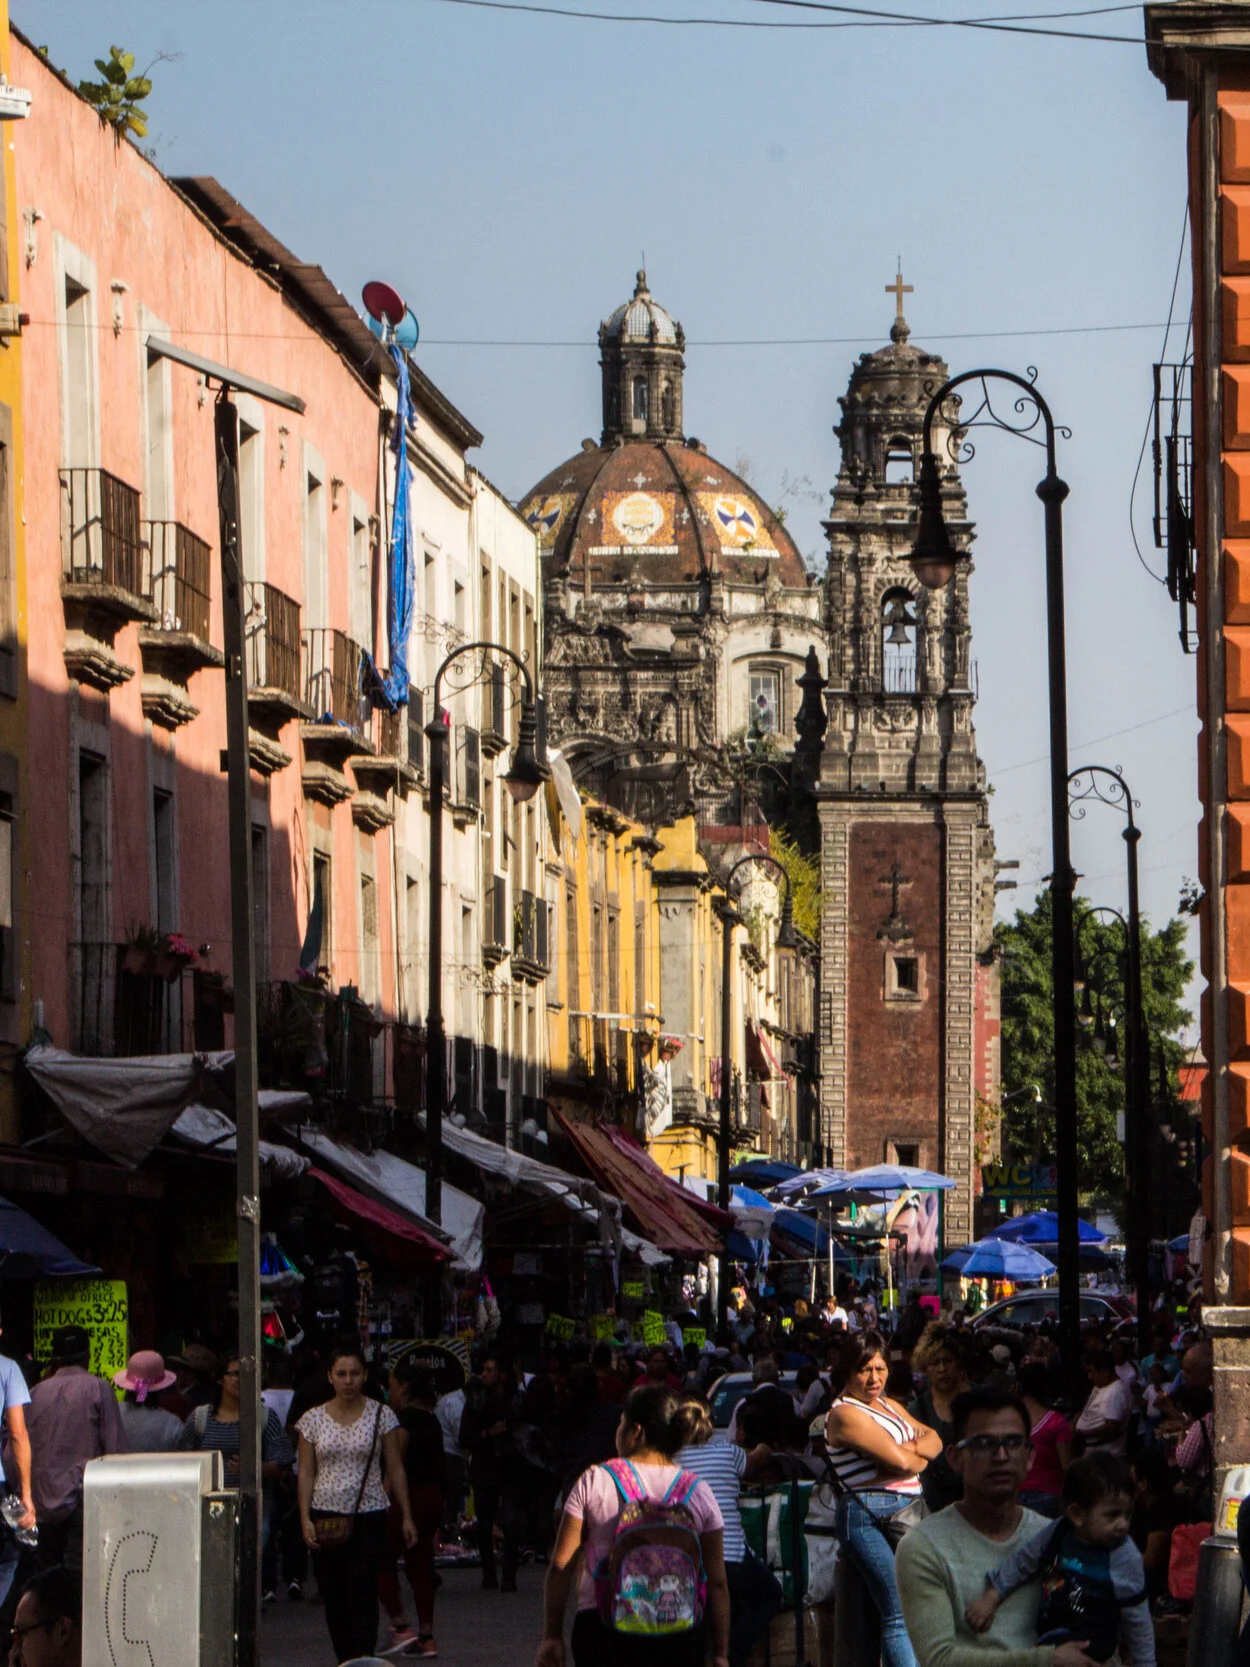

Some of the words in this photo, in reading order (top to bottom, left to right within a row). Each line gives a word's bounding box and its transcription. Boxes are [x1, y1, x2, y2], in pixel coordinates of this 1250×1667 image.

[982, 1166, 1031, 1187] WC
[80, 1292, 113, 1303] OFRECE
[34, 1308, 55, 1325] HOT
